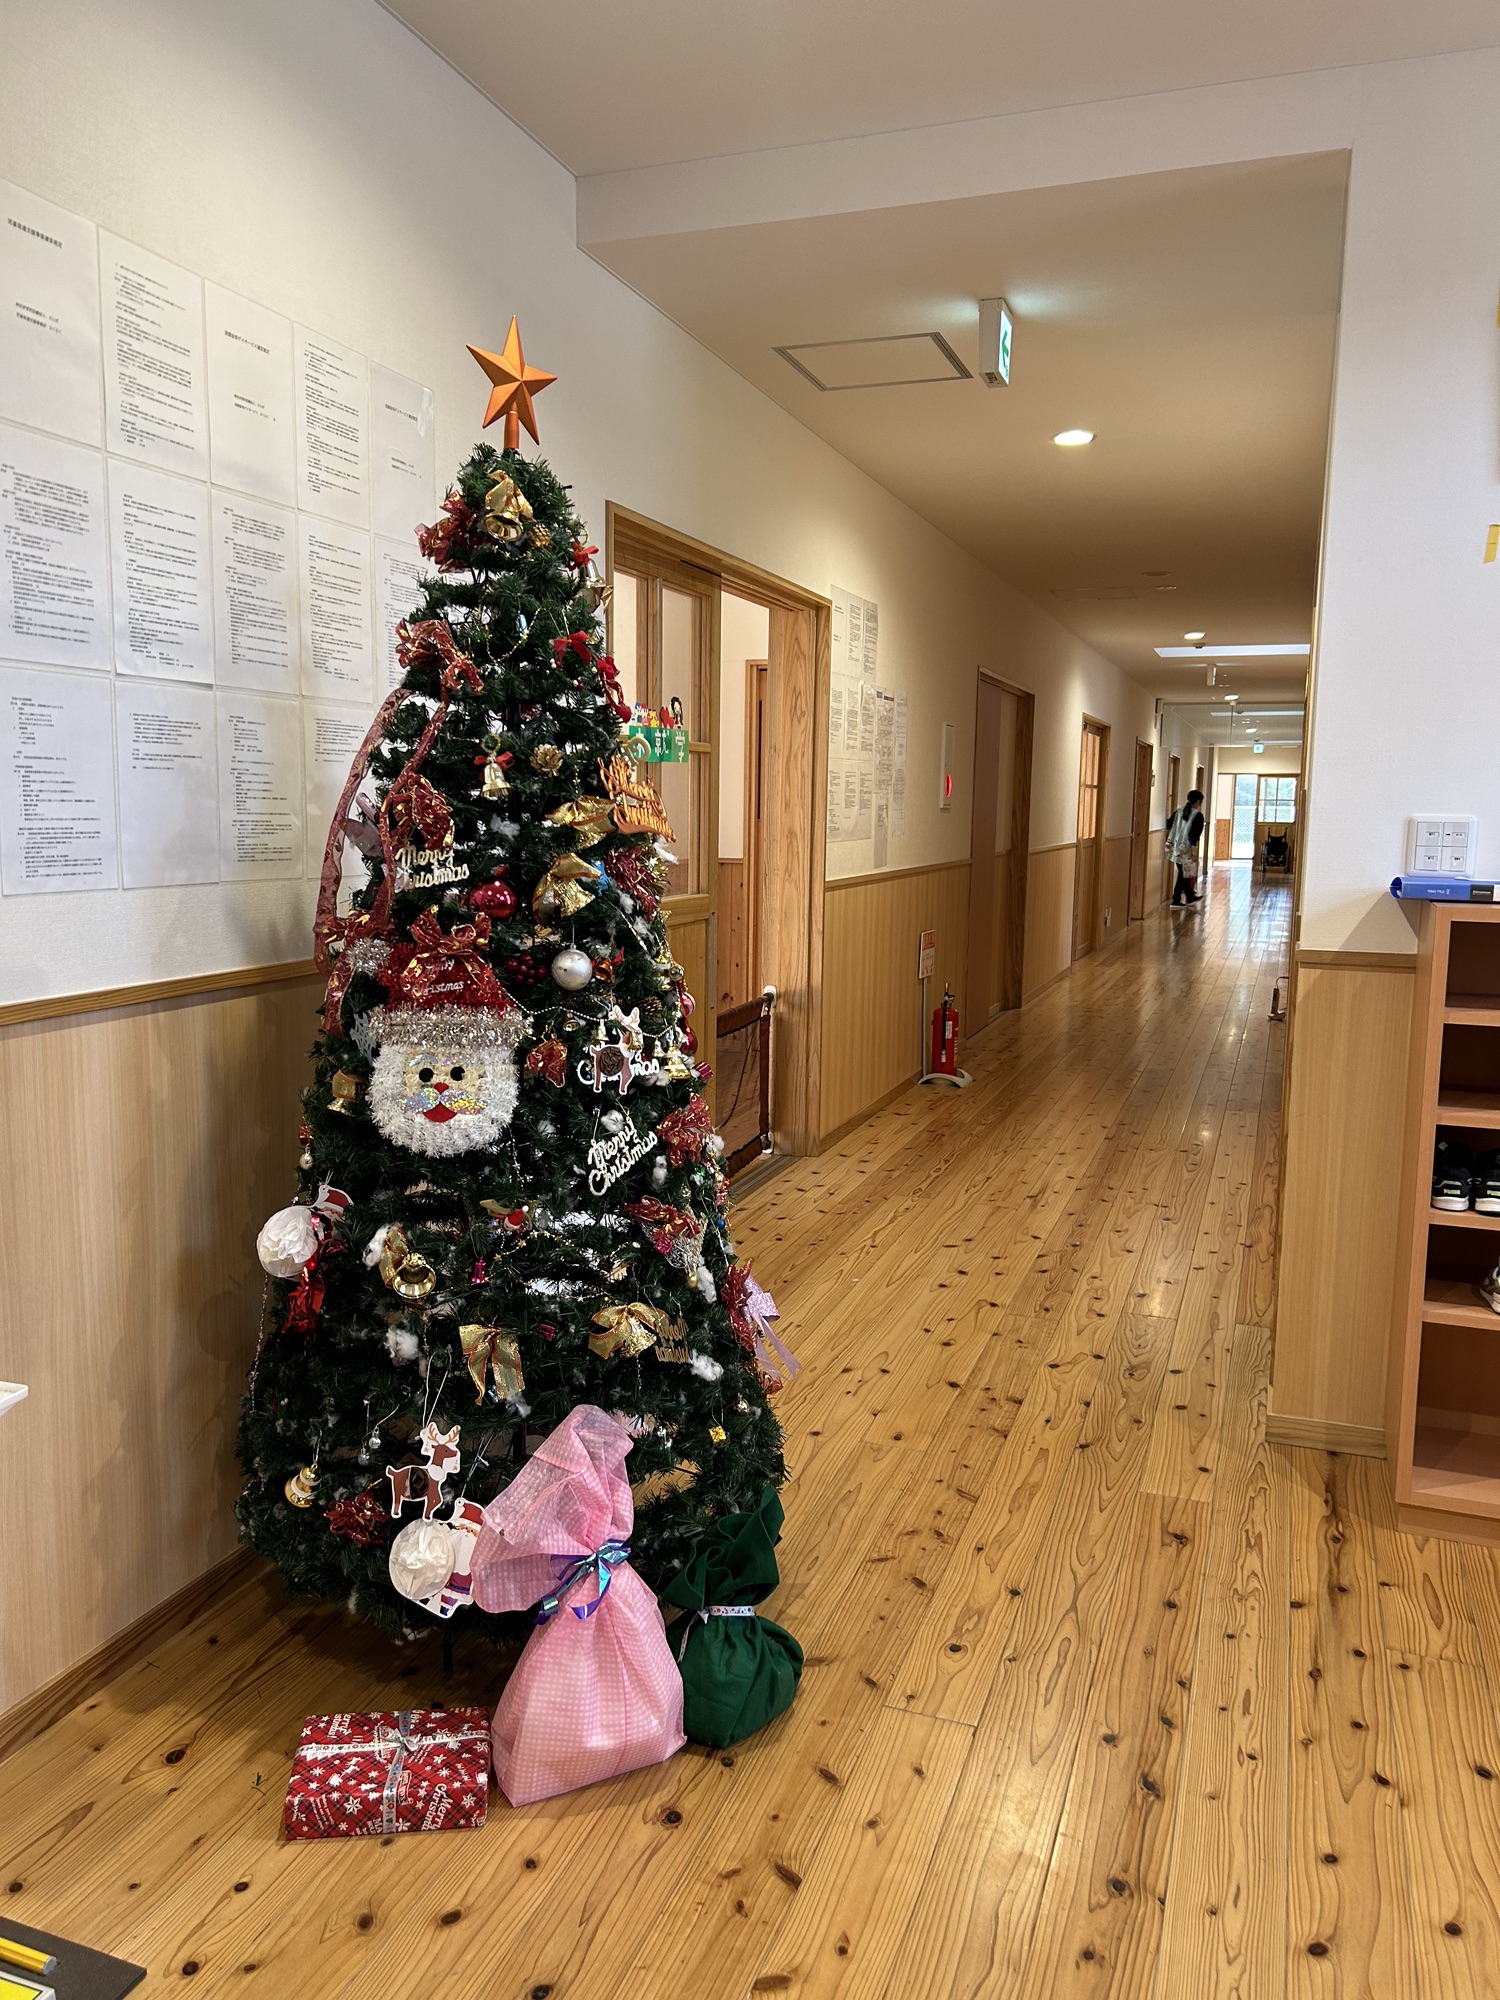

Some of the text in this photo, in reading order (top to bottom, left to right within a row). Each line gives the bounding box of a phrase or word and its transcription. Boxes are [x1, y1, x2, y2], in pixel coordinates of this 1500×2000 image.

[395, 845, 455, 869] Merry
[587, 1117, 638, 1168] Merry
[588, 1131, 658, 1196] Christmas
[421, 1783, 448, 1831] Christma
[430, 1796, 453, 1830] Merry
